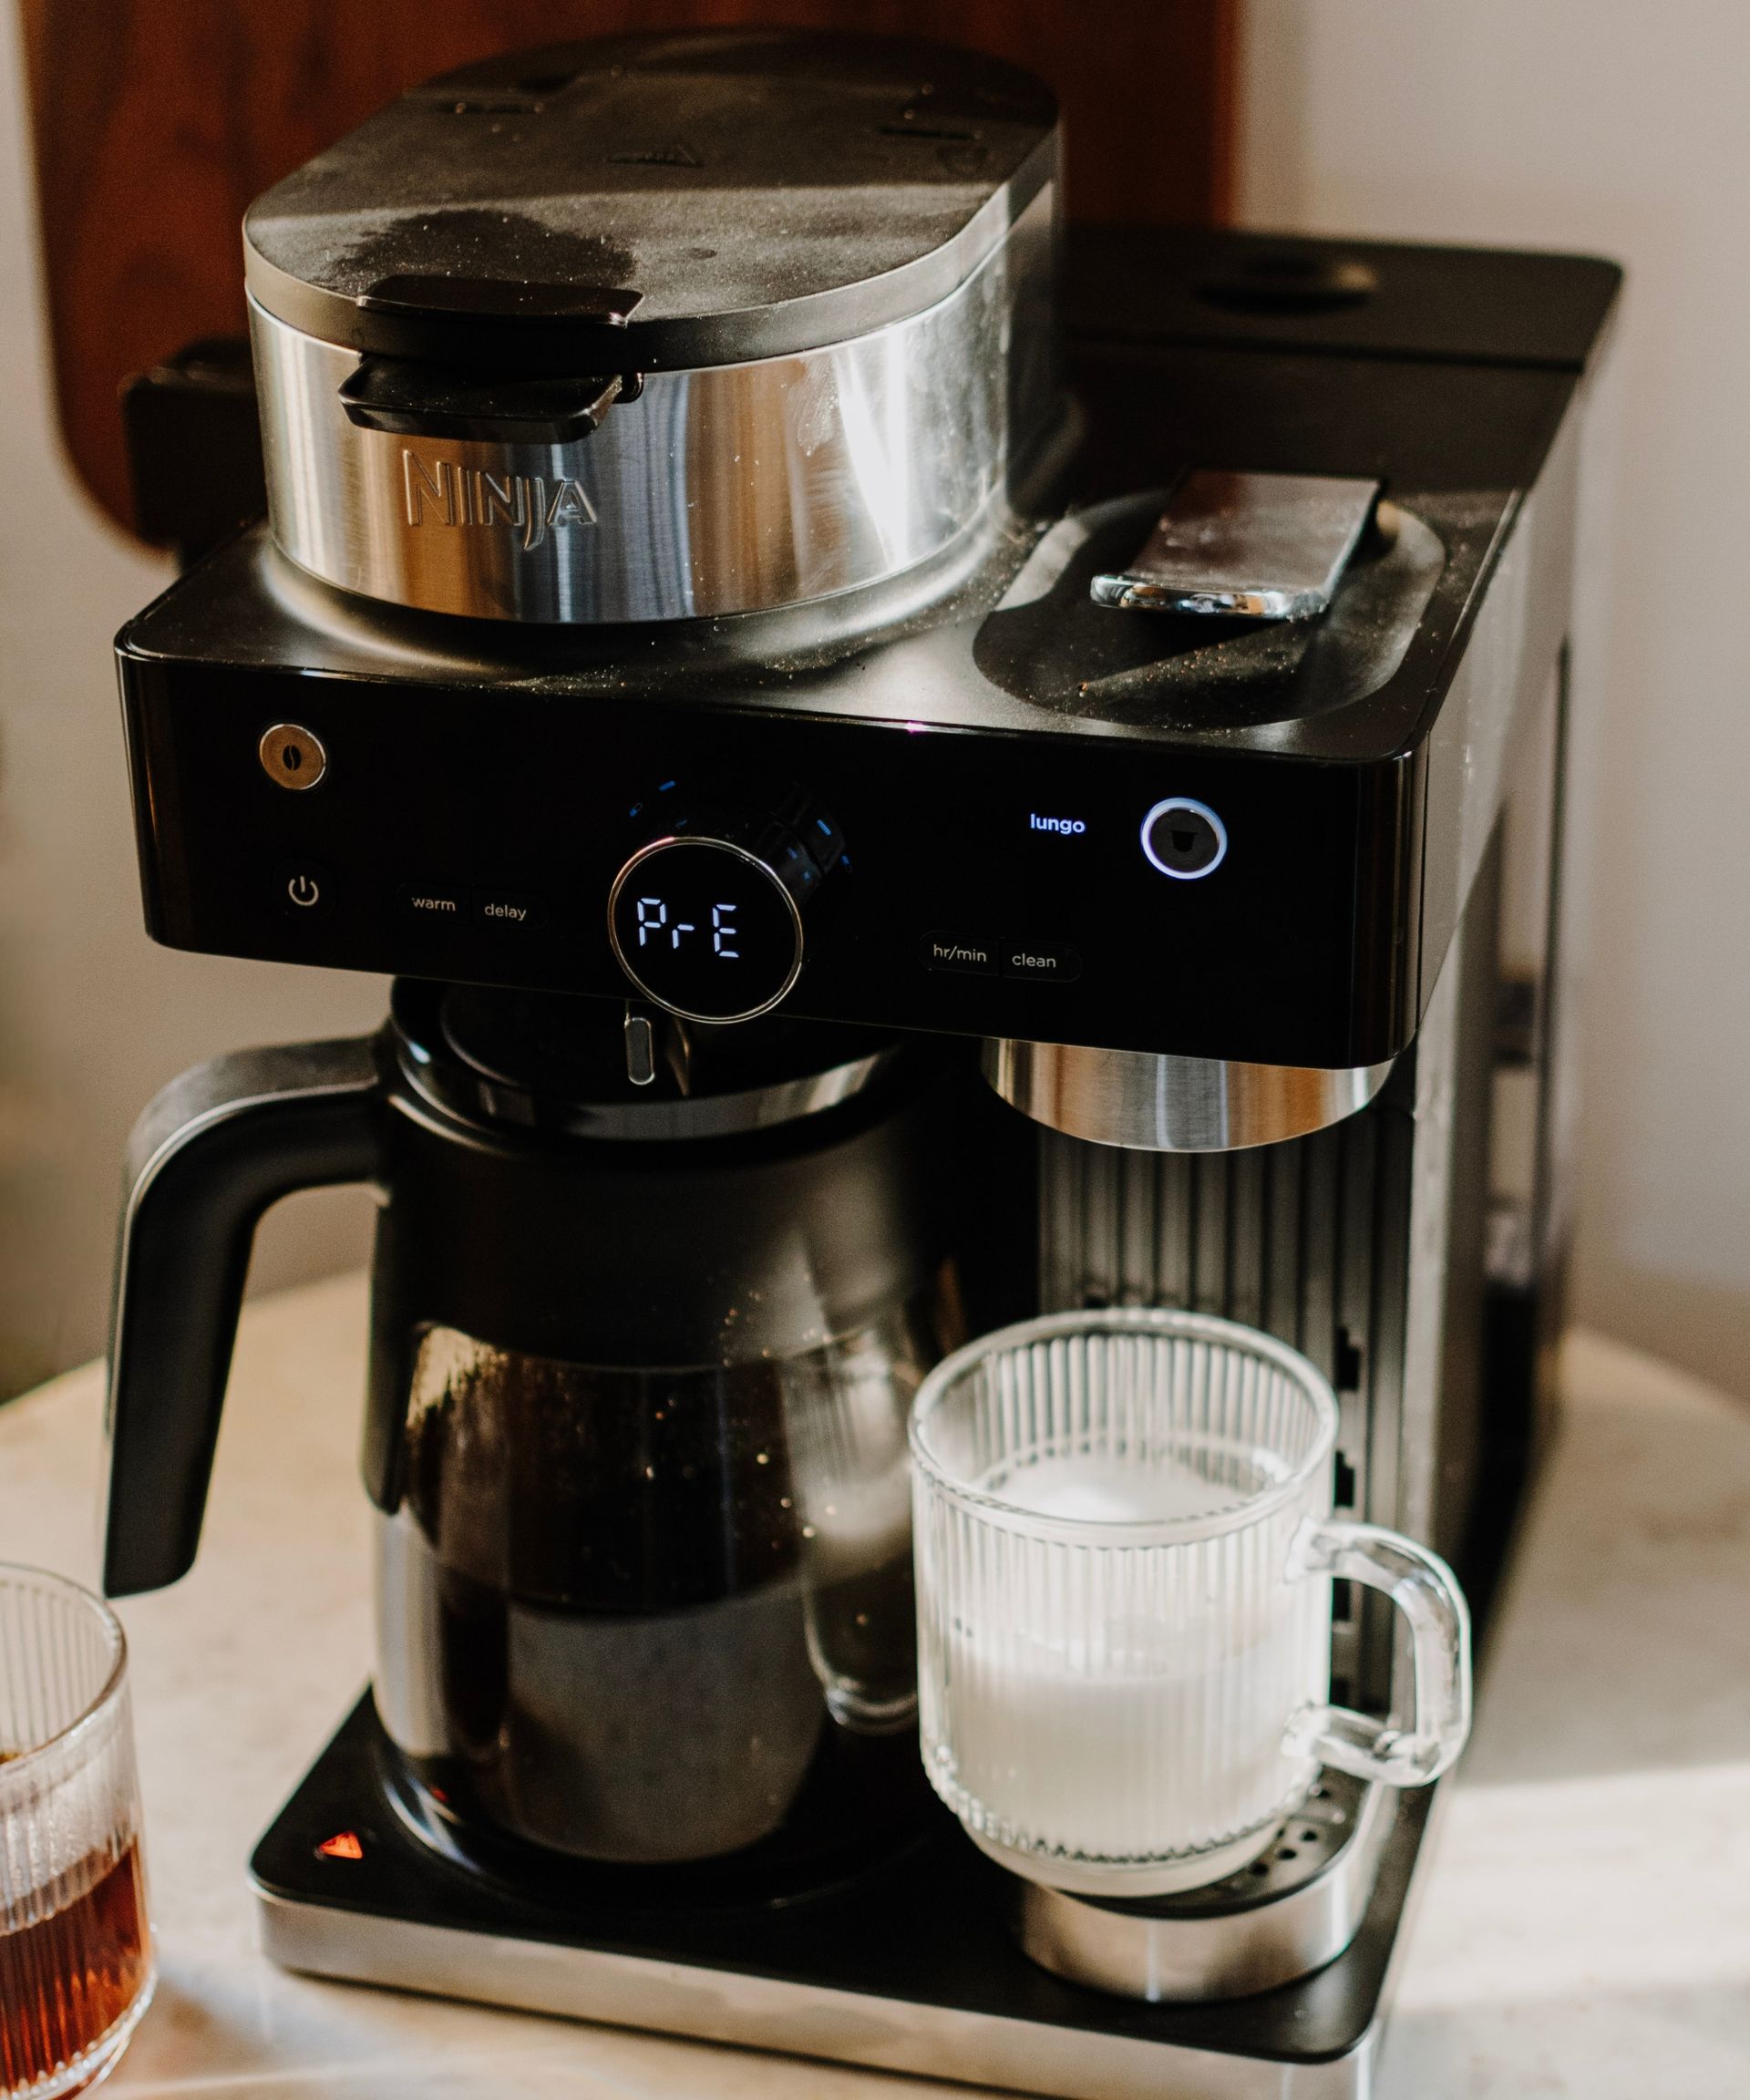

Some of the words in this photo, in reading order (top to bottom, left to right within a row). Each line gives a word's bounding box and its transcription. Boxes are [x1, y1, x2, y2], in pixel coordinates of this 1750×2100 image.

[403, 449, 597, 551] NINJA
[1030, 813, 1086, 835] lungo
[411, 896, 457, 912] warm
[484, 902, 527, 921] delay
[637, 898, 740, 958] PrE
[932, 943, 987, 962] hr/min
[1012, 952, 1056, 968] clean
